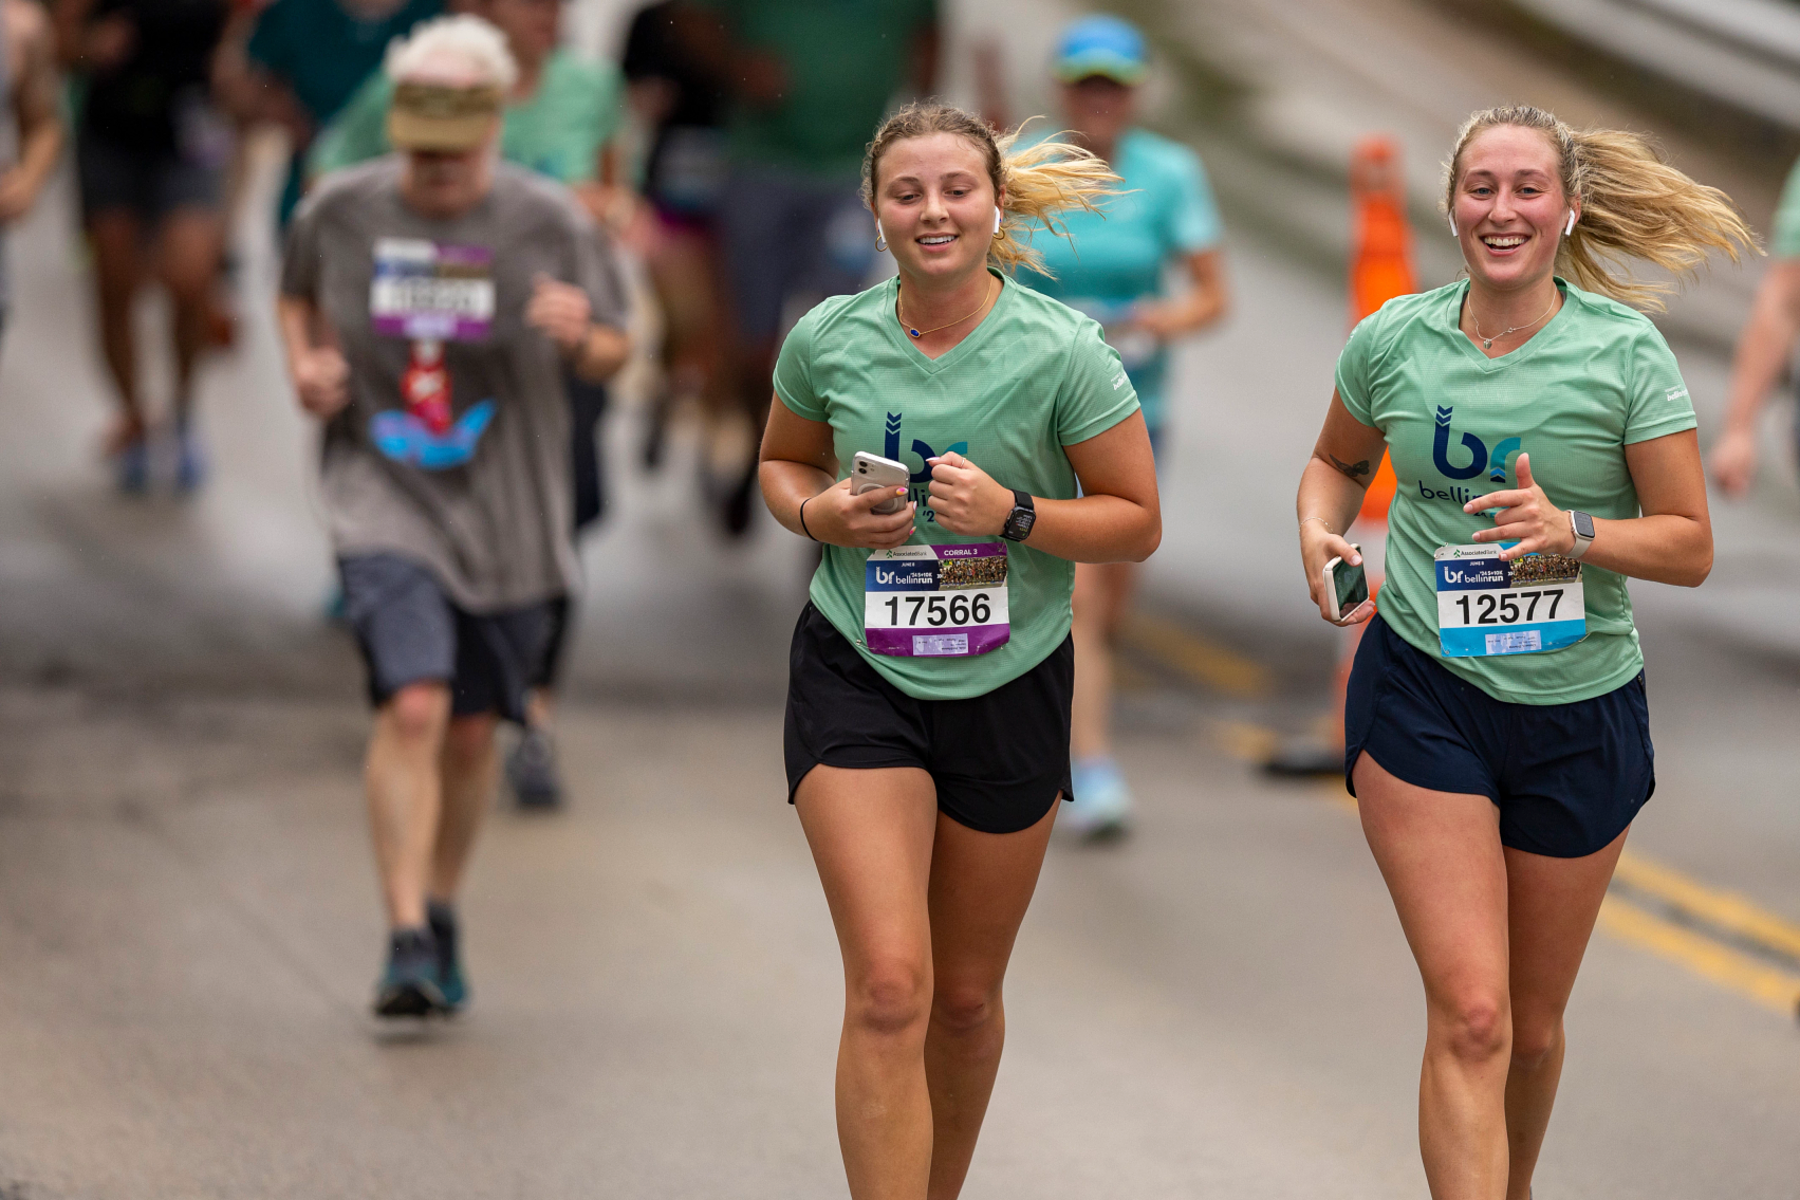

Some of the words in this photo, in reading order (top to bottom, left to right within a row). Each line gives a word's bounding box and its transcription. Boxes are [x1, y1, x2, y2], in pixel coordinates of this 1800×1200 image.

[1432, 404, 1522, 484] br
[1418, 480, 1483, 505] belli
[875, 566, 895, 585] br
[895, 575, 933, 585] bellinrun
[1443, 565, 1464, 584] br
[1464, 574, 1504, 584] bellinrun
[885, 593, 991, 626] 17566
[1456, 589, 1564, 625] 12577
